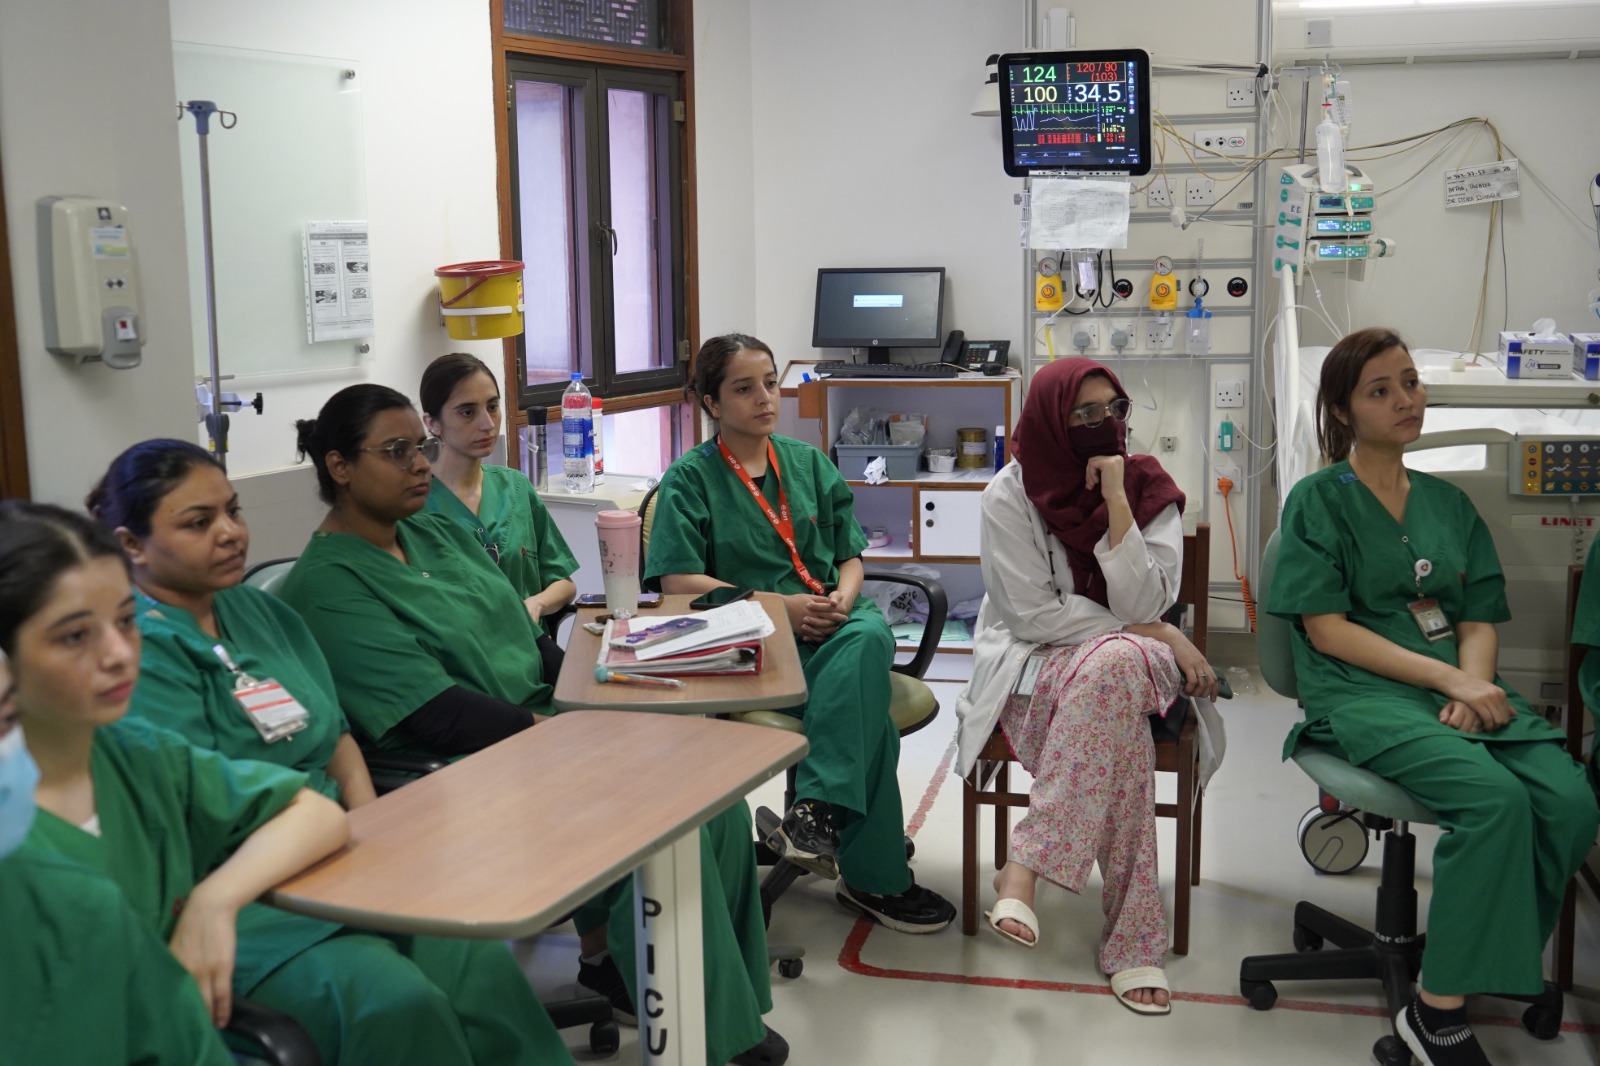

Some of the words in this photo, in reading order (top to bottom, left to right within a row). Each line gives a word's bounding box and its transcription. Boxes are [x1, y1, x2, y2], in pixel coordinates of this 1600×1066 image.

[1023, 66, 1057, 83] 124
[1077, 63, 1095, 72] 120
[1105, 62, 1118, 72] 90
[1091, 72, 1118, 82] (103)
[1024, 86, 1058, 103] 100
[1075, 83, 1121, 102] 34.5
[1541, 517, 1594, 526] LINET
[641, 895, 668, 1057] PICU
